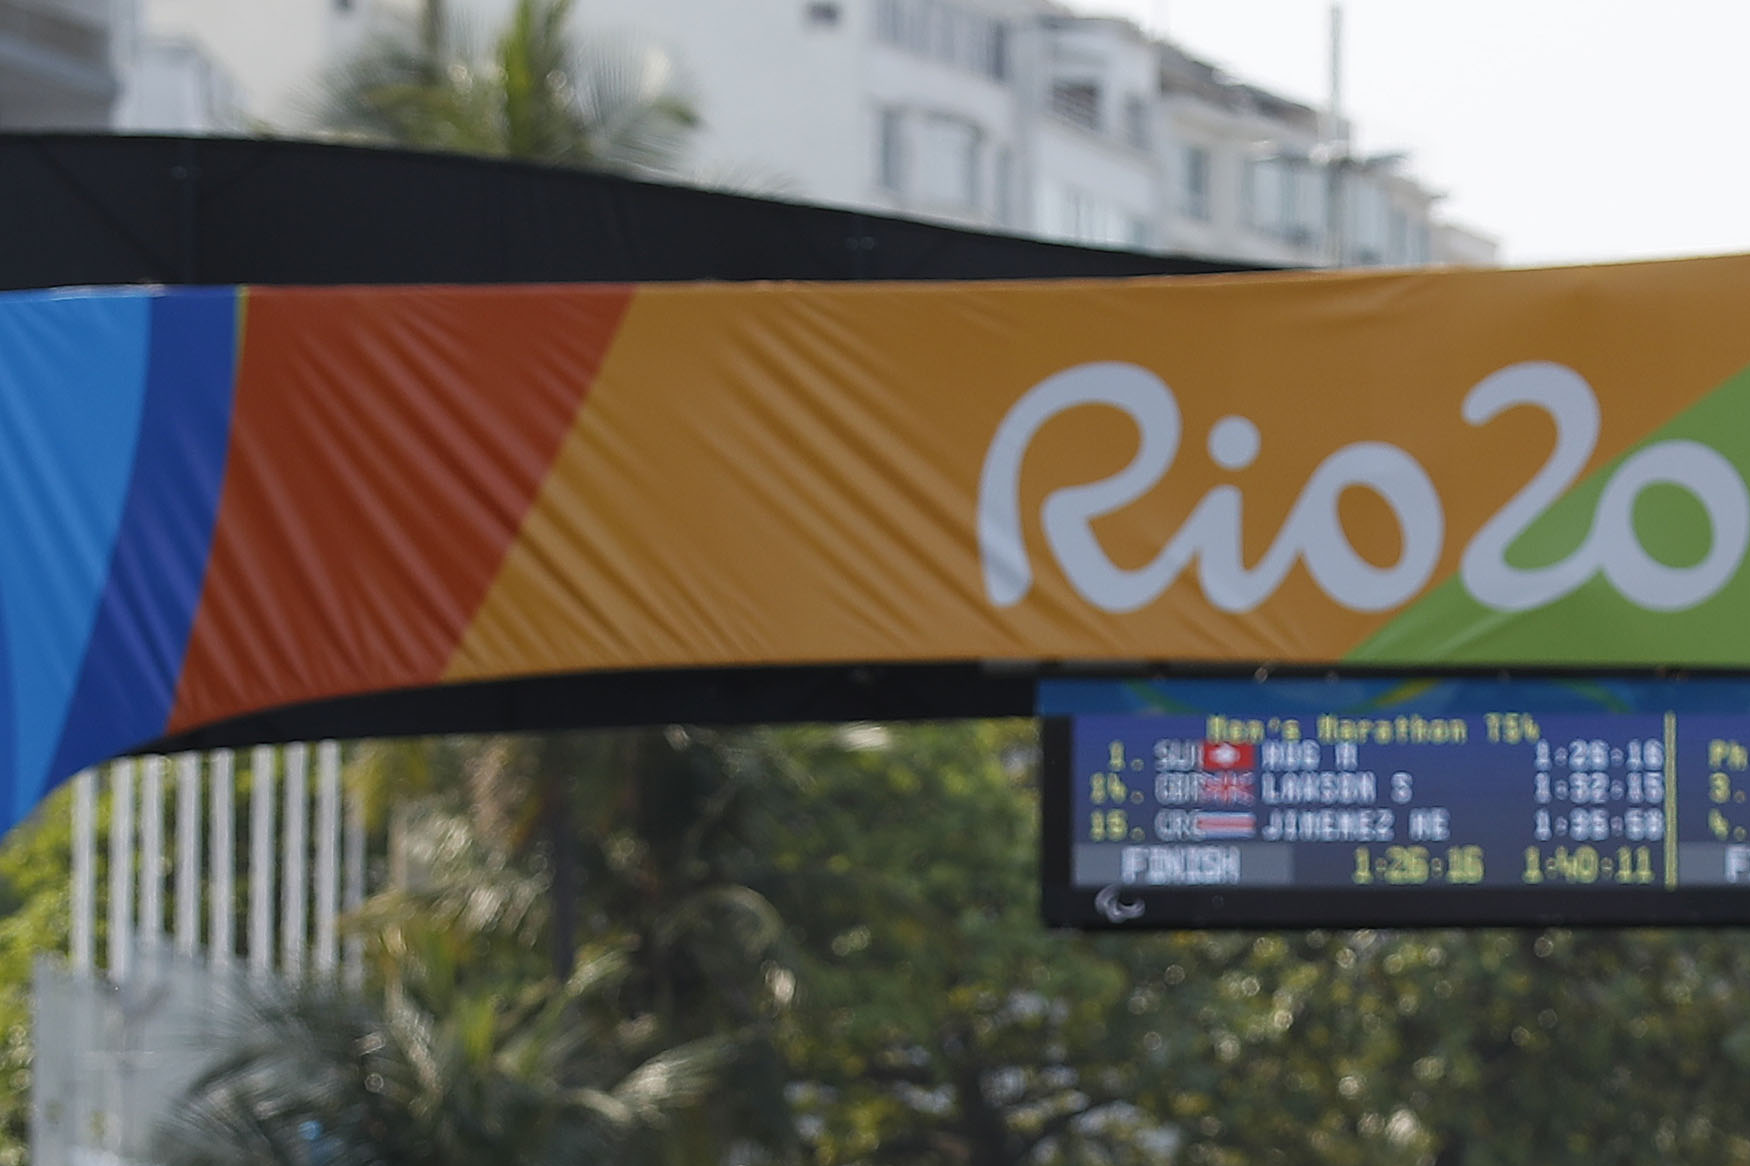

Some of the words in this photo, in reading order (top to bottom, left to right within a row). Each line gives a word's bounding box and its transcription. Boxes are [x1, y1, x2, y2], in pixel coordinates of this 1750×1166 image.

[1317, 713, 1468, 744] Marathon
[1485, 712, 1540, 744] T54
[1122, 846, 1242, 885] FINISH
